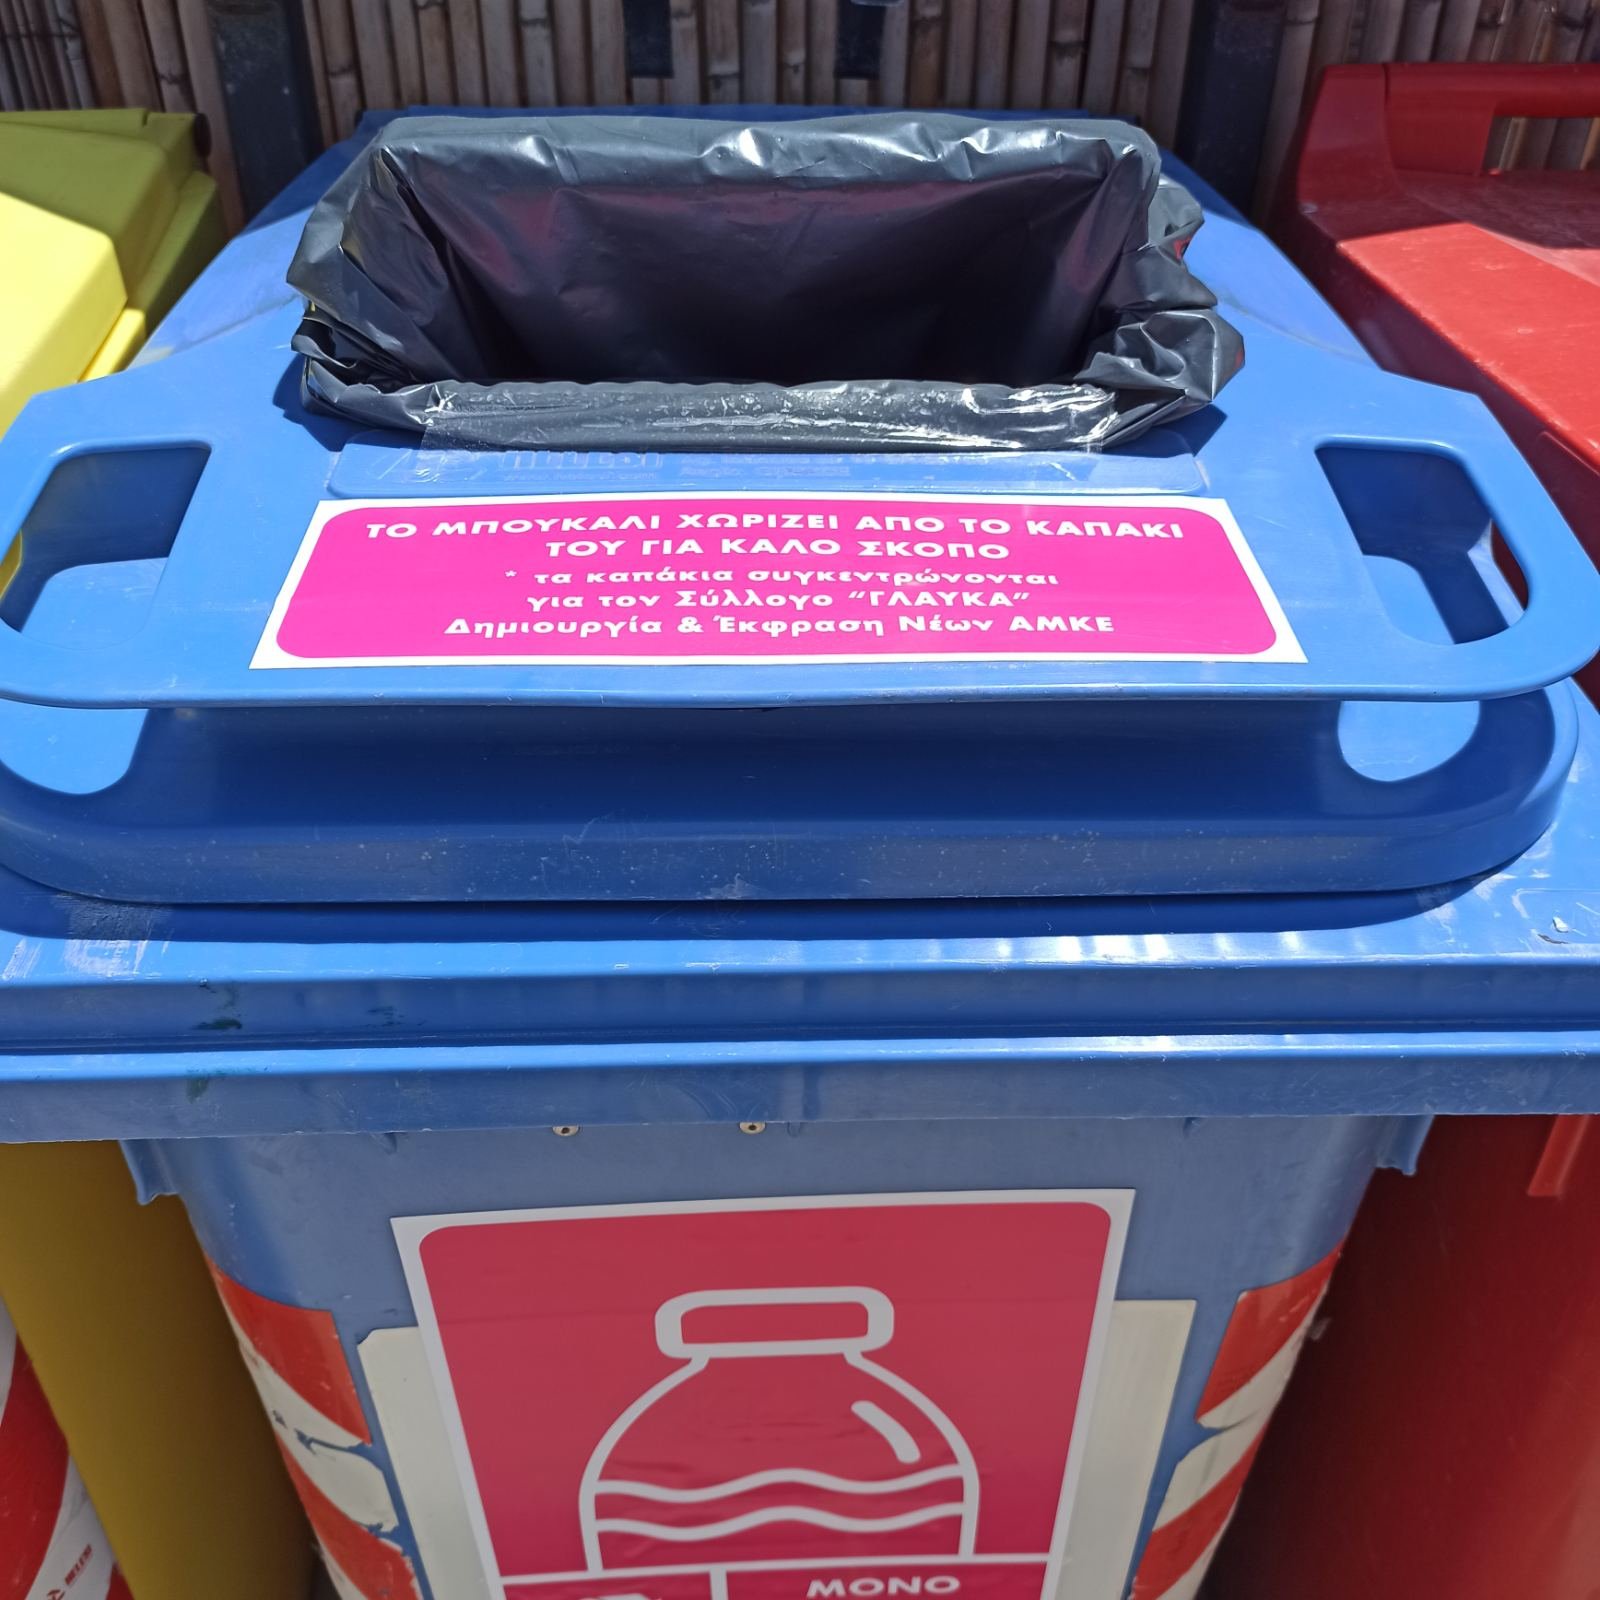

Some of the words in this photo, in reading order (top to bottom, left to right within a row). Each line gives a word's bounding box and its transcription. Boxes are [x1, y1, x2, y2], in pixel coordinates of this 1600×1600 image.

[366, 522, 418, 539] ΤΟ
[432, 514, 660, 536] ΜΠΟΥΚΑΛΙ
[676, 513, 839, 529] ΧΩΡΙΖΕΙ
[854, 515, 945, 533] ΑΠΟ
[958, 518, 1011, 535] ΤΟ
[1025, 519, 1184, 539] ΚΑΠΑΚΙ
[545, 540, 626, 558] ΤΟΥ
[641, 538, 704, 556] ΓΙΑ
[721, 538, 841, 555] ΚΑΛΟ
[857, 540, 1010, 561] ΣΚΟΠΟ
[534, 573, 573, 584] τα
[586, 566, 733, 584] καπάκια
[747, 567, 1059, 587] συγκεντρώνονται
[527, 595, 584, 613] για
[598, 594, 661, 608] τον
[674, 588, 833, 610] Σύλλογο
[443, 614, 664, 640] Δημιουργία
[676, 615, 705, 634] &
[712, 614, 885, 638] Έκφραση
[898, 613, 994, 633] Νέων
[1008, 615, 1115, 633] ΑΜΚΕ
[806, 1575, 961, 1599] ΜΟΝΟ
